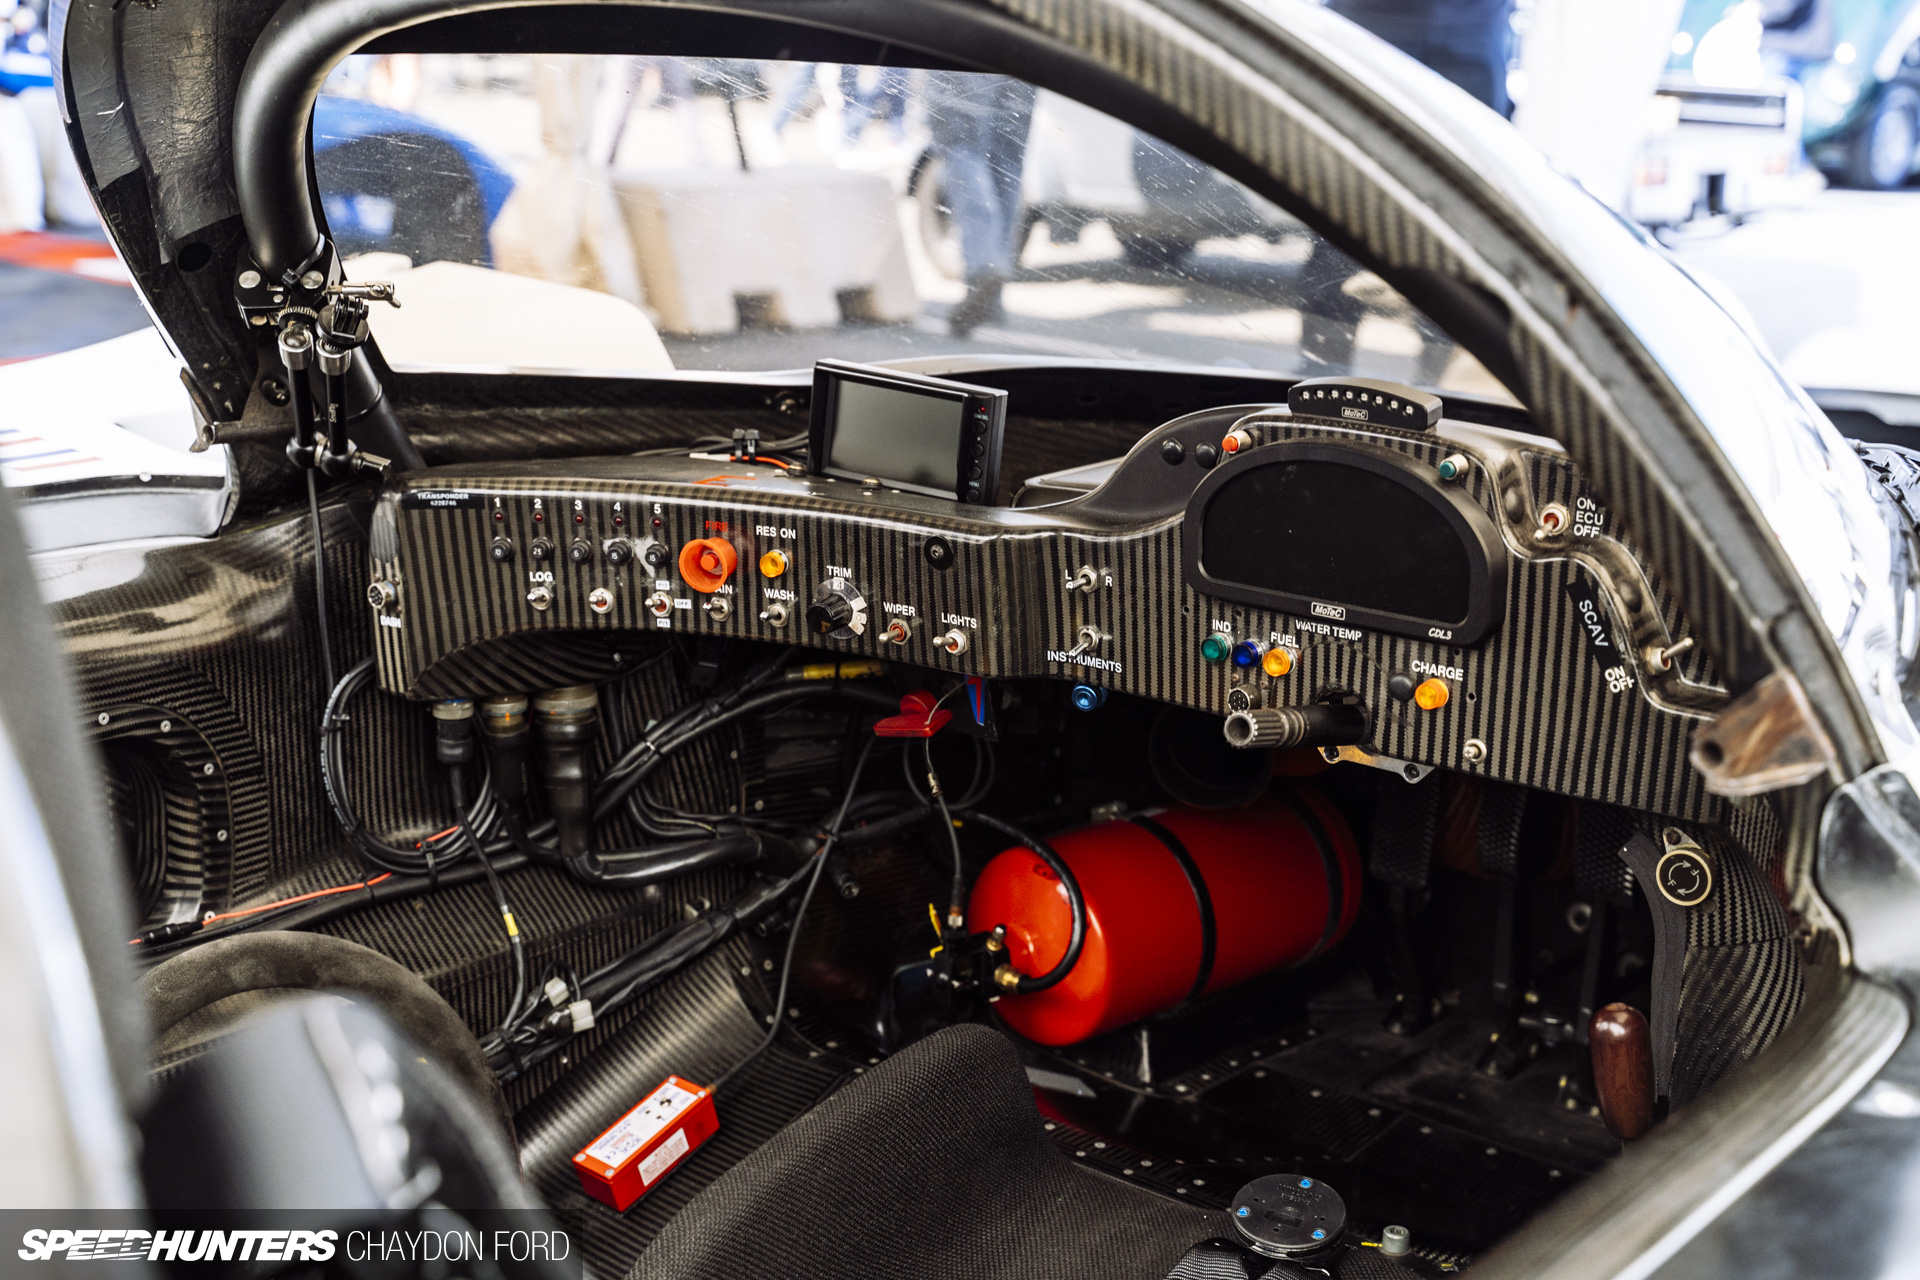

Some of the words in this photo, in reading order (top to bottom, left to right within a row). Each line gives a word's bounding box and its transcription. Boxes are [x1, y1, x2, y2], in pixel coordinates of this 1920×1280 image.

[1344, 409, 1366, 418] MoTeC
[417, 492, 469, 500] TRANSPONDER
[494, 497, 500, 507] 1
[534, 498, 542, 509] 2
[574, 499, 583, 510] 3
[614, 501, 621, 512] 4
[654, 503, 662, 514] 5
[1577, 497, 1596, 511] ON
[1576, 510, 1604, 526] ECU
[705, 520, 728, 532] FIRE
[756, 525, 777, 537] RES
[780, 528, 796, 539] ON
[1573, 523, 1600, 538] OFF
[494, 548, 502, 556] 10
[533, 547, 542, 556] 25
[611, 552, 618, 560] 15
[649, 554, 656, 562] 15
[529, 571, 553, 582] LOG
[827, 565, 852, 578] TRIM
[1065, 569, 1072, 580] L
[1105, 575, 1113, 587] R
[715, 584, 733, 595] AIN
[764, 588, 794, 601] WASH
[883, 602, 916, 617] WIPER
[1314, 605, 1343, 618] MoTeC
[380, 615, 402, 629] DASH
[941, 612, 977, 629] LIGHTS
[1212, 619, 1231, 632] IND
[1579, 599, 1609, 646] SCAV
[1295, 619, 1331, 636] WATER
[1332, 626, 1362, 641] TEMP
[1428, 627, 1452, 640] CDL3
[1271, 632, 1299, 648] FUEL
[1411, 660, 1464, 681] CHARGE
[1604, 665, 1626, 682] ON
